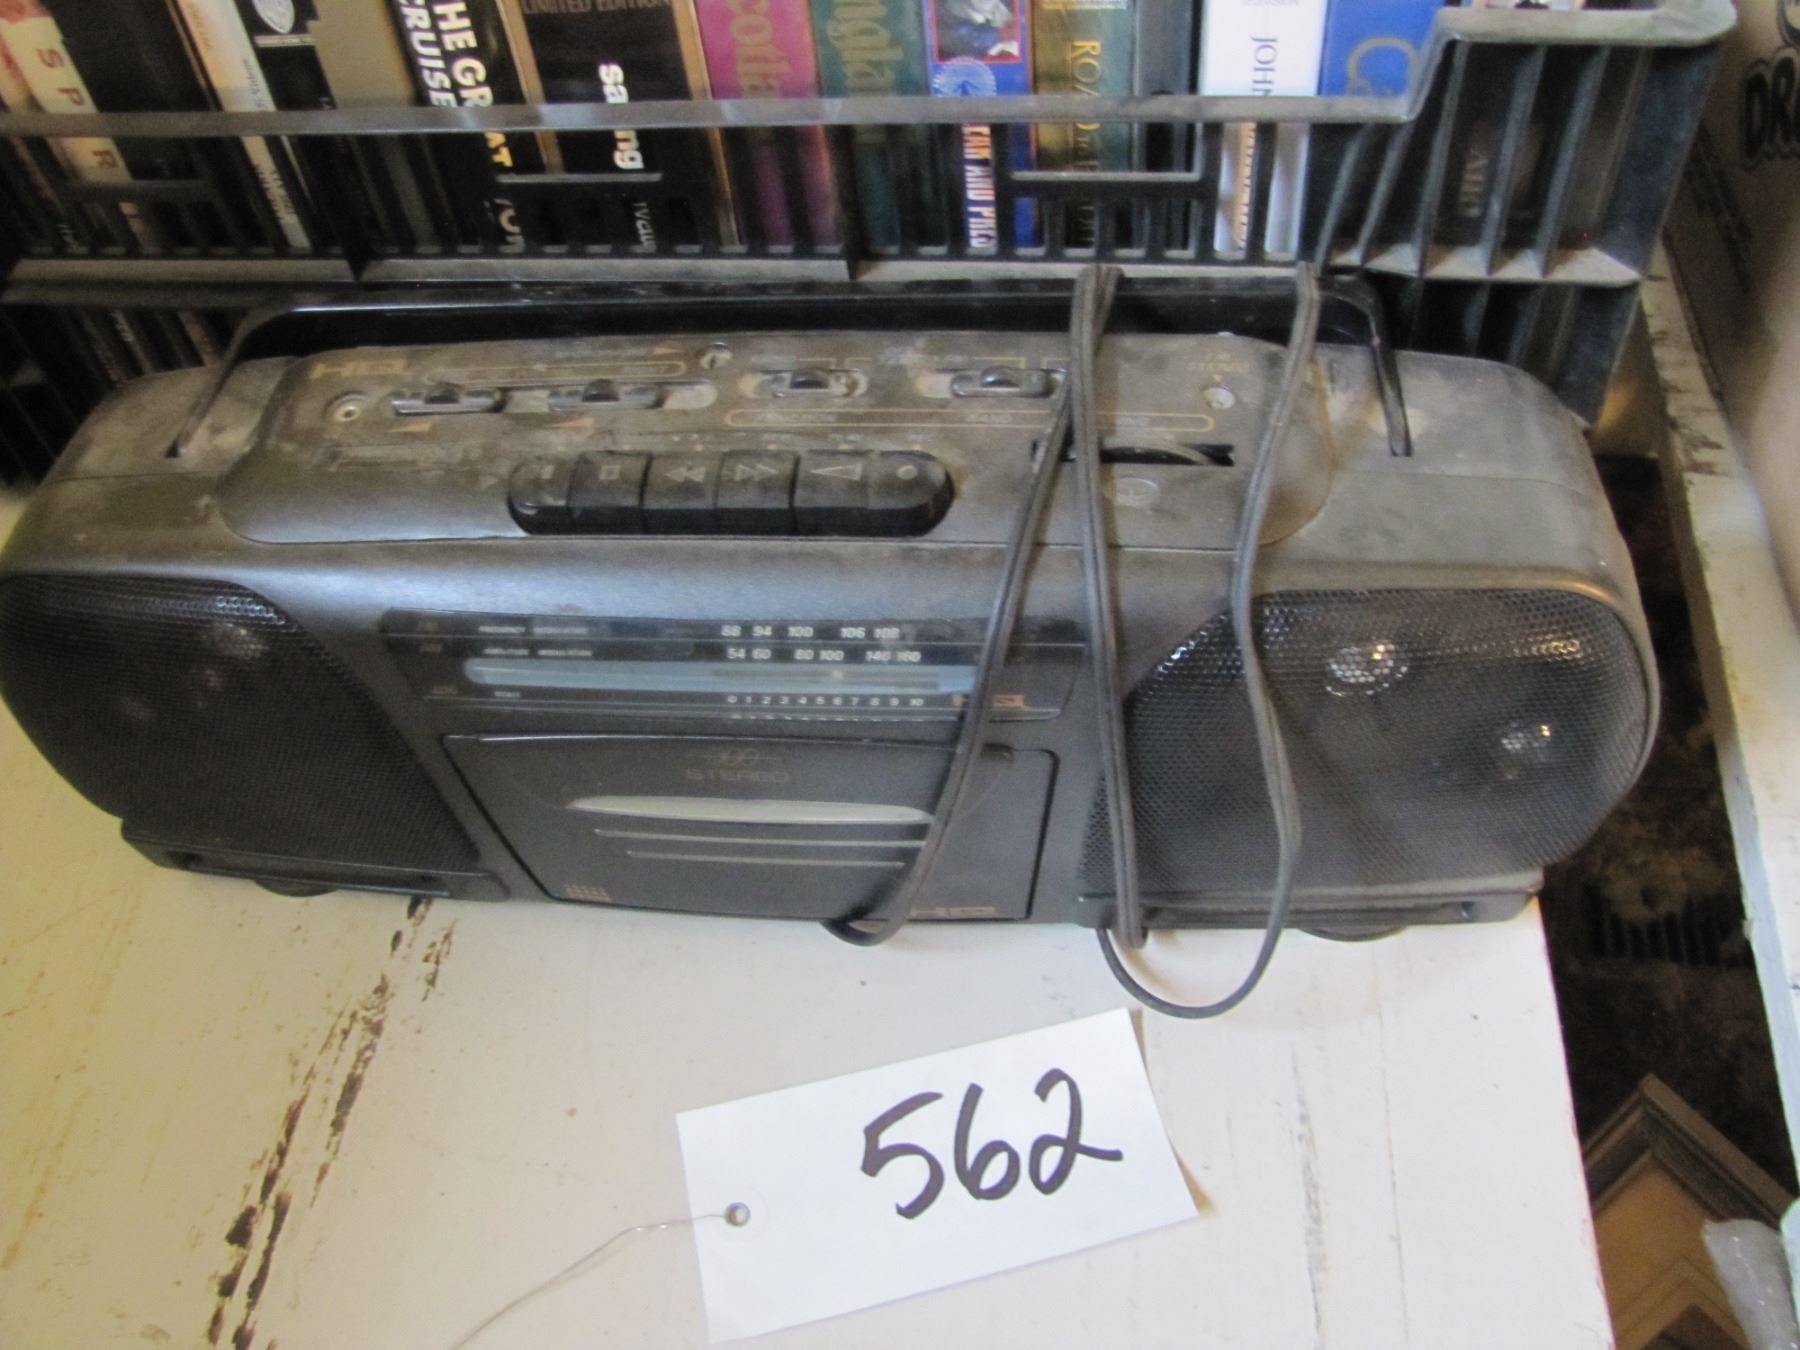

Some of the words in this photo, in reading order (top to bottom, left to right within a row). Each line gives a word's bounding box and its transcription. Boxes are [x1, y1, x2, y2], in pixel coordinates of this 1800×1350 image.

[433, 1, 478, 51] HE
[452, 58, 514, 167] GRAT
[1743, 55, 1800, 164] DR
[727, 648, 746, 659] 54
[819, 649, 844, 661] 100
[788, 626, 814, 638] 100
[861, 1067, 1123, 1219] 562
